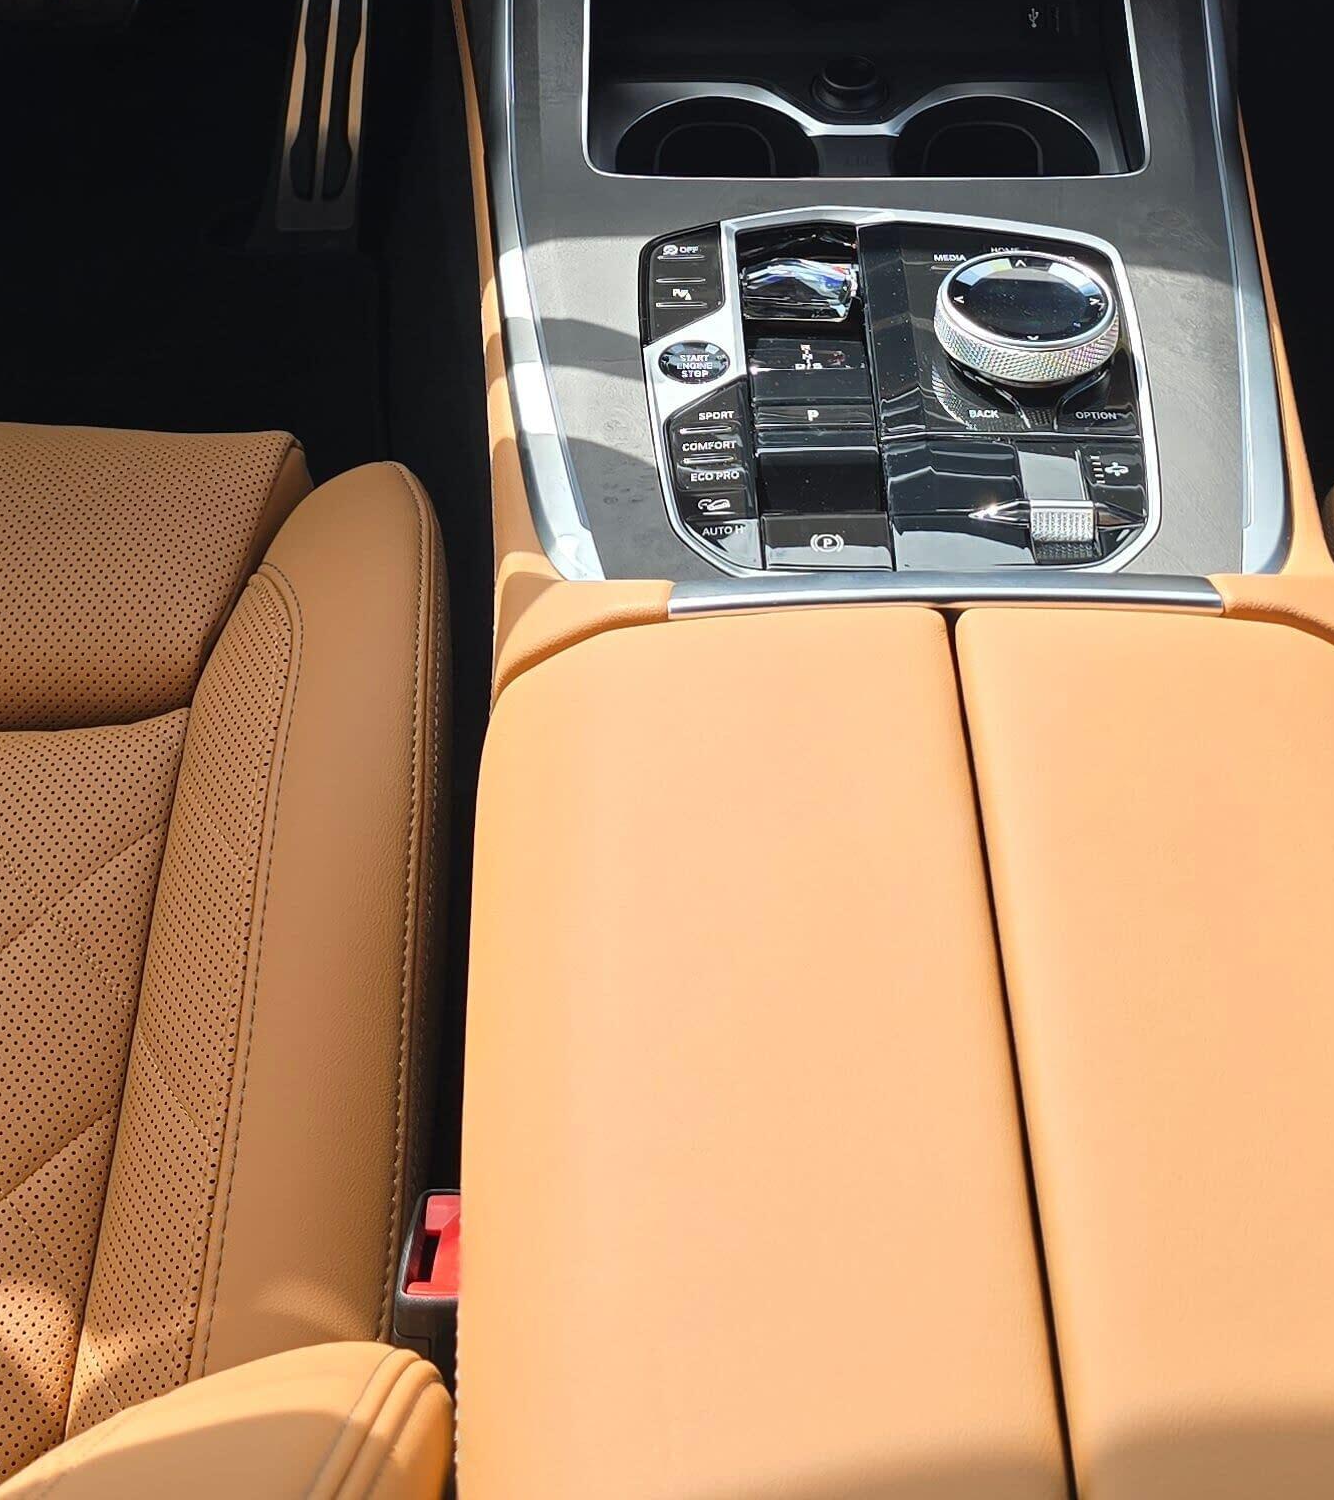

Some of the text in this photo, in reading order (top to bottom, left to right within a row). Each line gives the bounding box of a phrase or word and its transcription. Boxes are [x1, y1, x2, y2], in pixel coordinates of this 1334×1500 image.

[679, 246, 699, 254] OFF
[933, 254, 966, 262] MEDIA
[677, 362, 713, 370] ENGINE
[681, 370, 709, 378] STOP
[698, 410, 735, 421] SPORT
[807, 409, 820, 421] P
[968, 409, 999, 420] BACK
[1075, 410, 1118, 421] OPTION
[682, 440, 737, 452] COMFORT
[690, 470, 740, 482] ECO PRO
[702, 524, 745, 536] AUTO H
